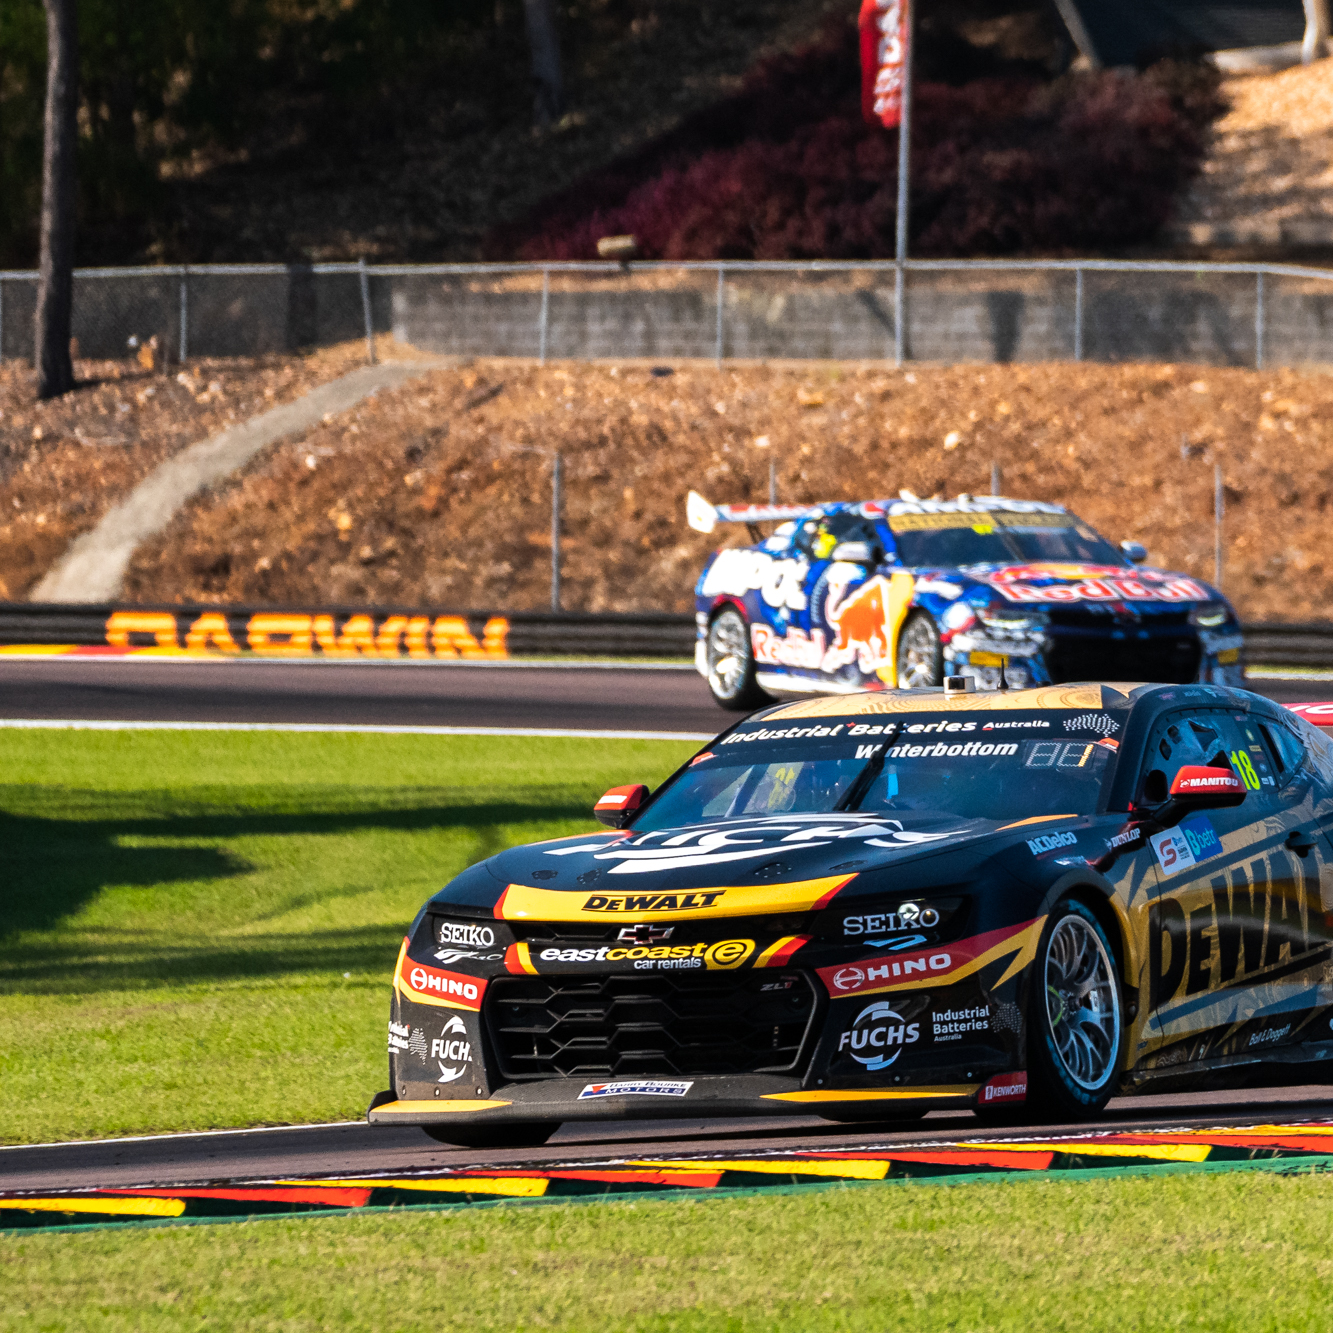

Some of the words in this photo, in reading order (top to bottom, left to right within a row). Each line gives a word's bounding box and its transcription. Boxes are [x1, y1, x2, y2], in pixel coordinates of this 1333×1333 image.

[106, 612, 510, 660] DARWIN
[721, 723, 843, 745] Industrial
[982, 720, 1050, 730] Australia
[1231, 750, 1261, 790] 18
[1189, 777, 1239, 787] MANITOU
[1027, 832, 1078, 855] ACDelco
[1111, 828, 1141, 848] DUNLOP
[1196, 828, 1217, 850] betr
[843, 908, 940, 936] SEIKO
[441, 923, 495, 947] SEIKO
[540, 941, 708, 962] eastcoast
[634, 959, 654, 969] car
[656, 956, 701, 969] rentals
[867, 953, 952, 981] HINO
[428, 975, 478, 1000] HINO
[932, 1005, 990, 1022] Industrial
[838, 1023, 920, 1052] FUCHS
[933, 1019, 989, 1034] Batteries
[934, 1034, 962, 1042] Australia
[992, 1084, 1027, 1098] KENWORTH
